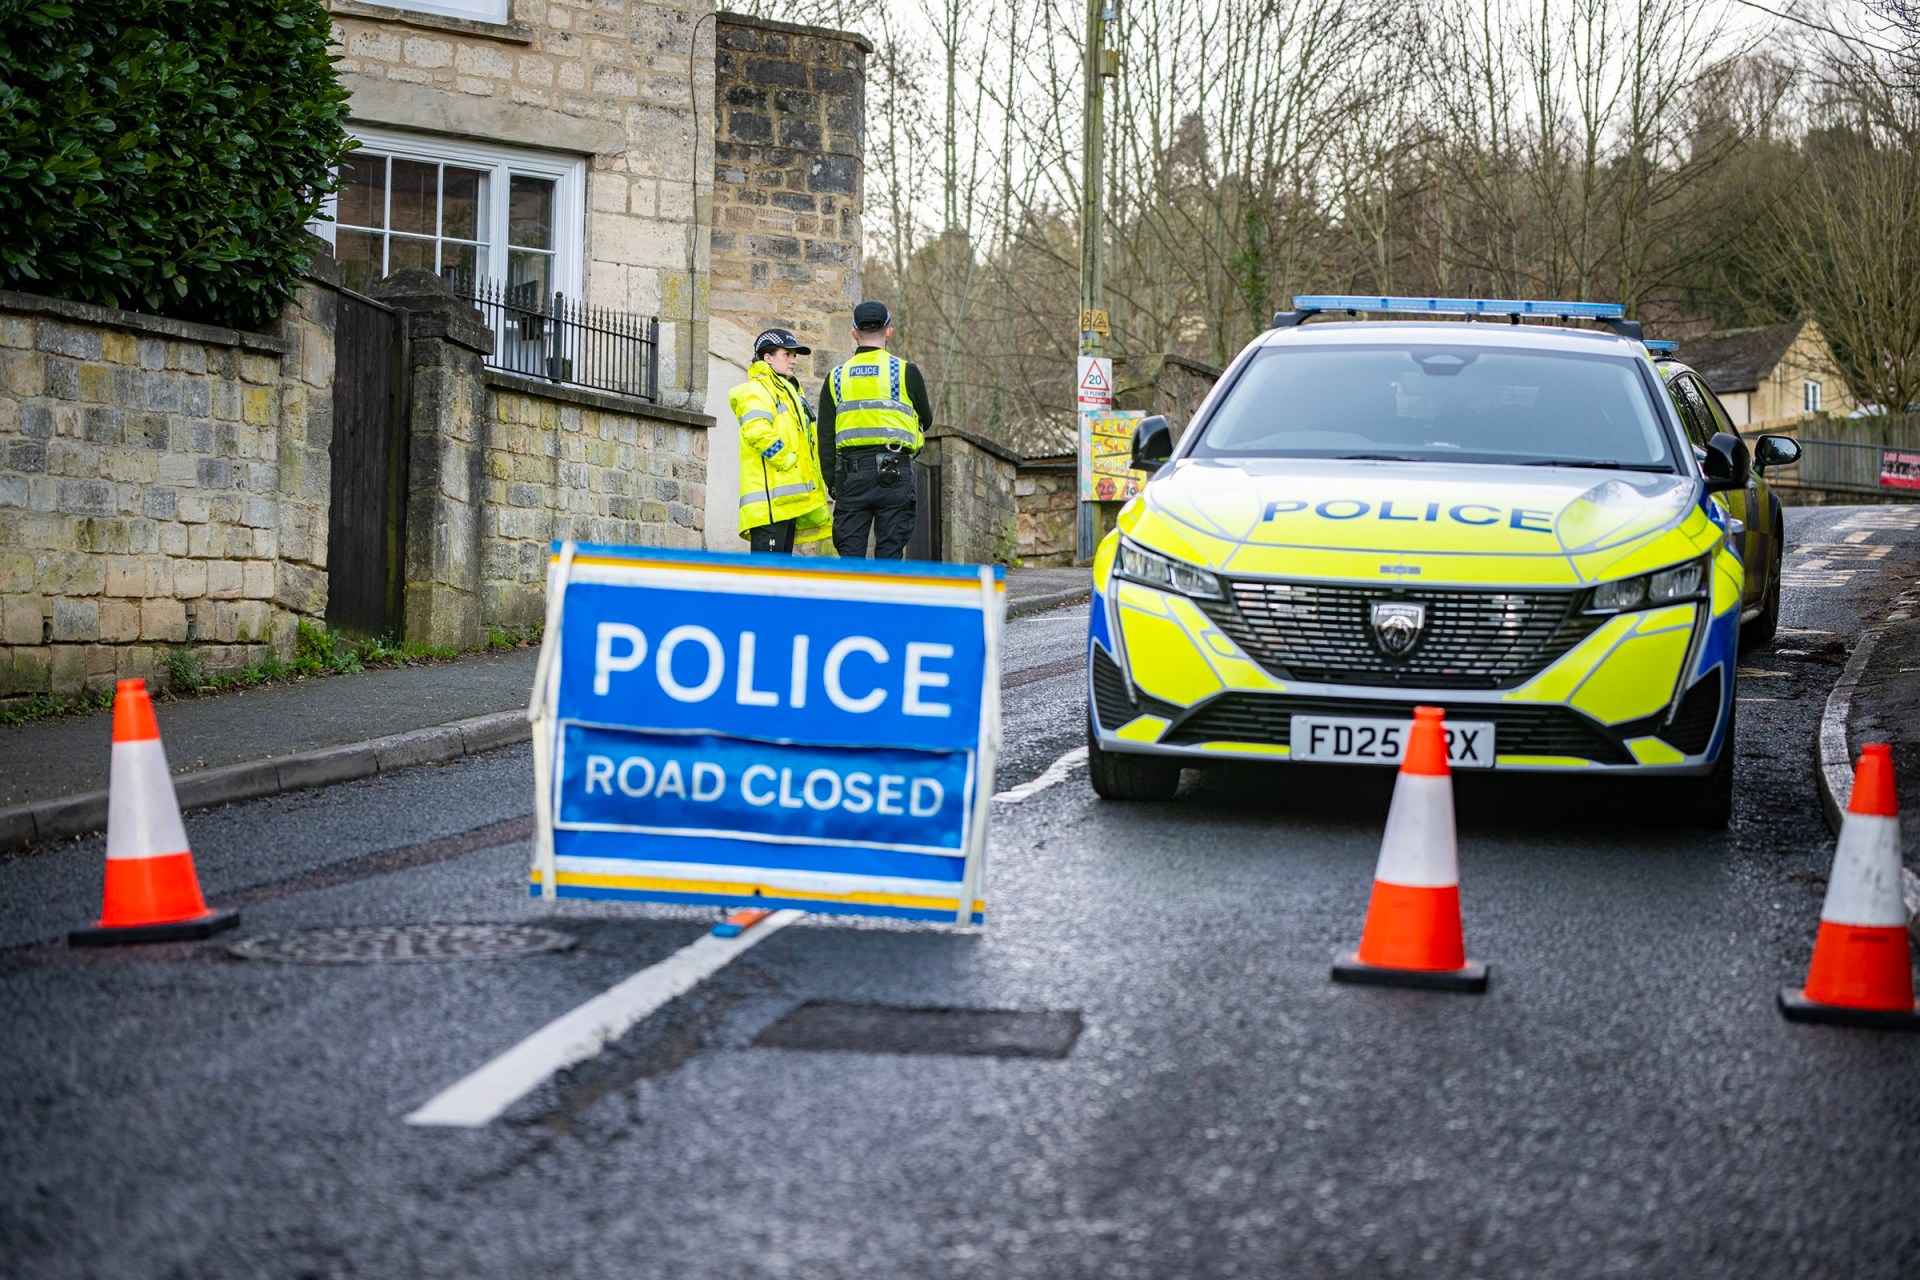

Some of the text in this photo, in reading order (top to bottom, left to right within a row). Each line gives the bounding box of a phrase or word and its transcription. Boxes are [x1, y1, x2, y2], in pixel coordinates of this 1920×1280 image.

[850, 366, 878, 376] POLICE
[1089, 374, 1102, 385] 20
[1099, 483, 1115, 497] 20
[1262, 500, 1553, 533] POLICE
[593, 622, 954, 717] POLICE
[1310, 725, 1400, 757] FD25
[586, 755, 945, 817] ROAD CLOSED
